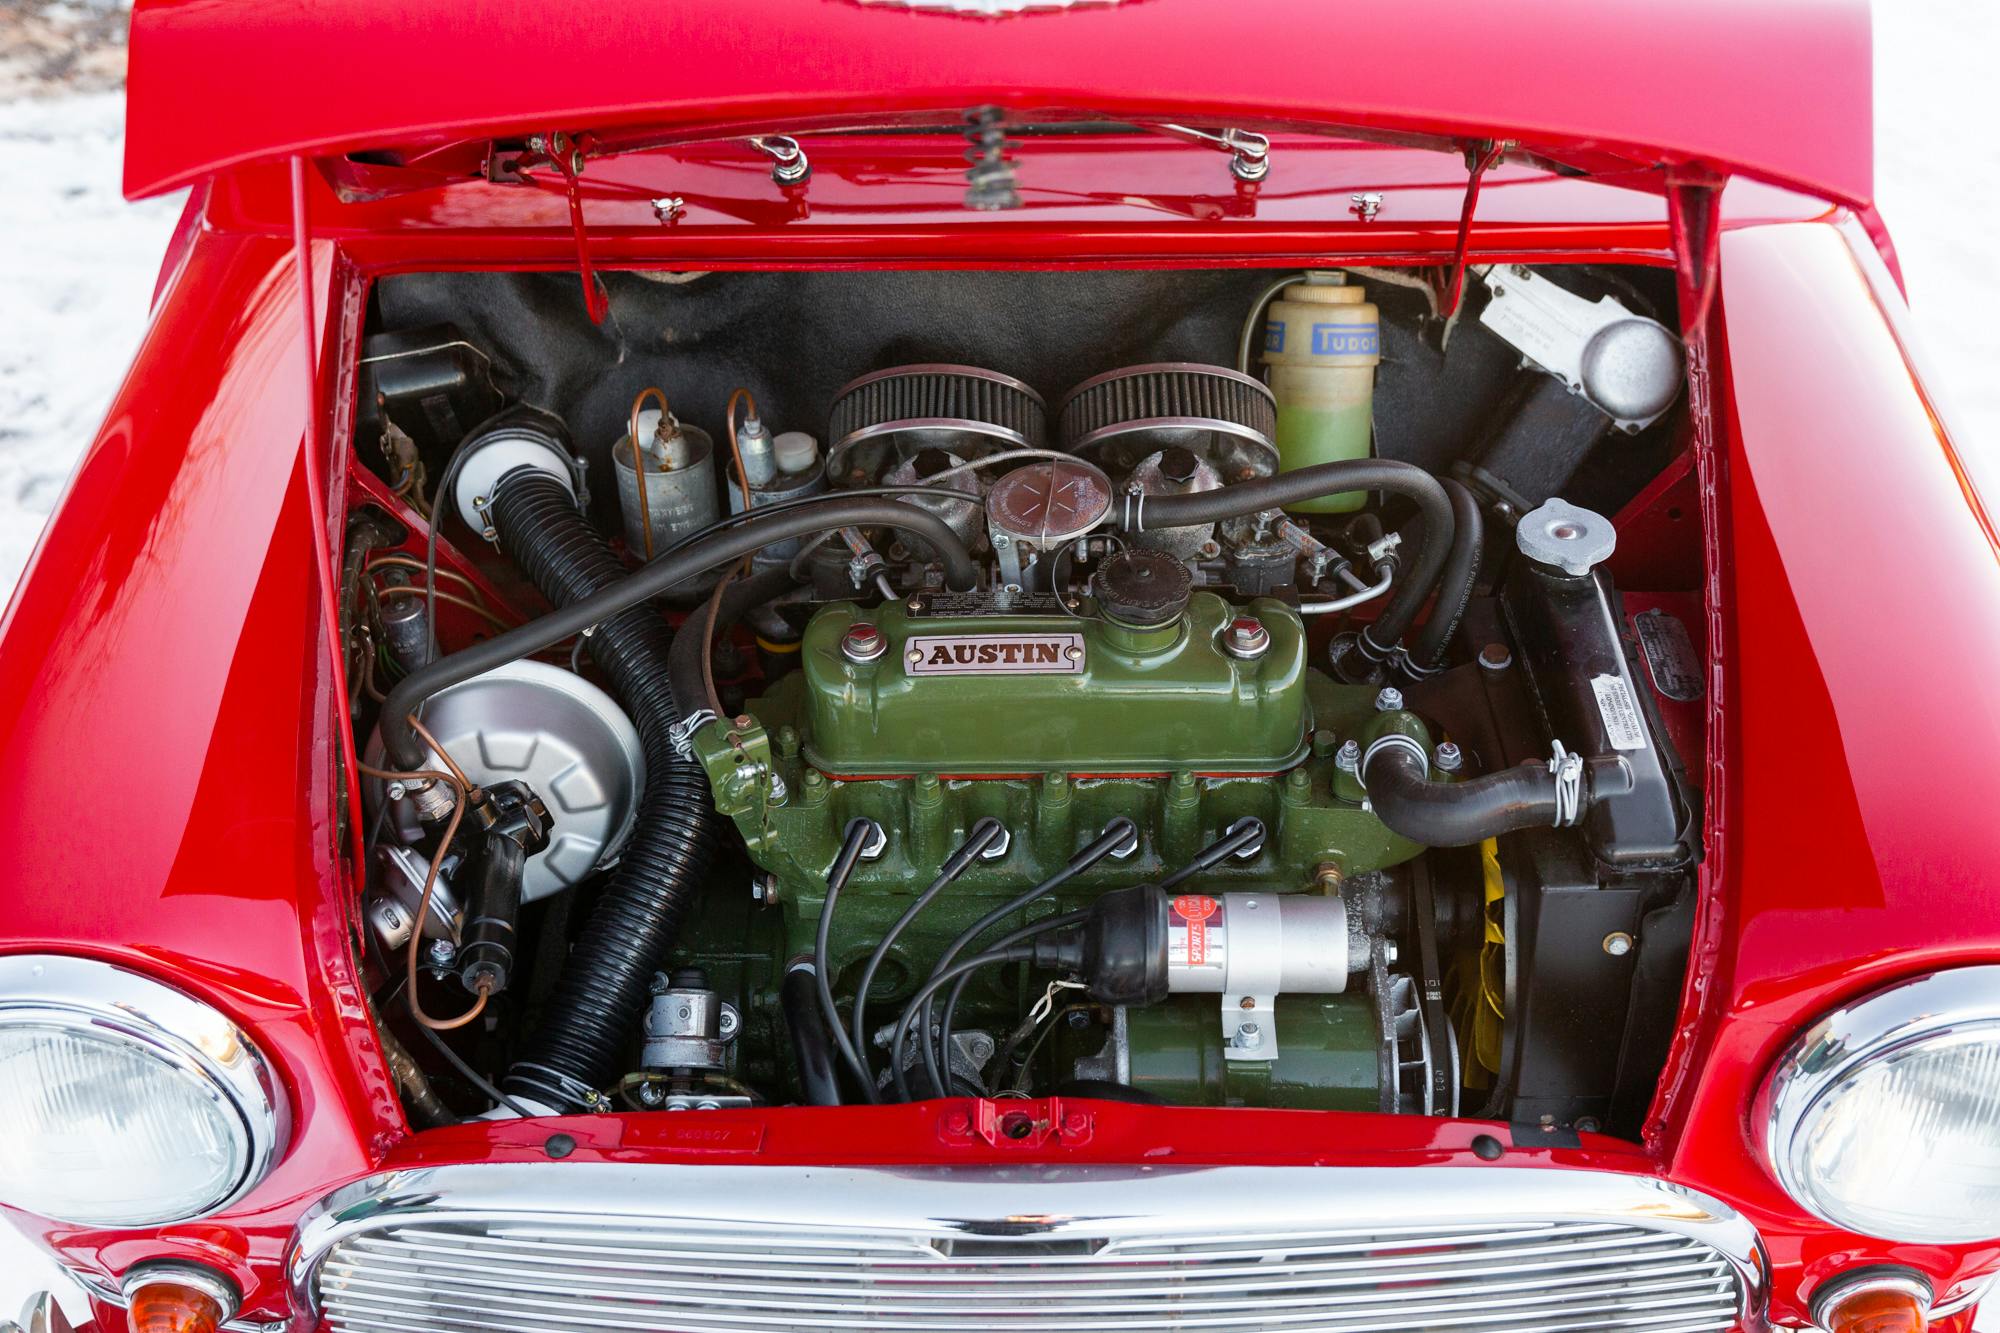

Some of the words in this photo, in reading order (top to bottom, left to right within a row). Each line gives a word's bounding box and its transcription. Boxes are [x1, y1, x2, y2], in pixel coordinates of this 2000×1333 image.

[1455, 571, 1477, 618] PRESSURE
[927, 643, 1061, 666] AUSTIN
[1191, 924, 1202, 962] SPORTS
